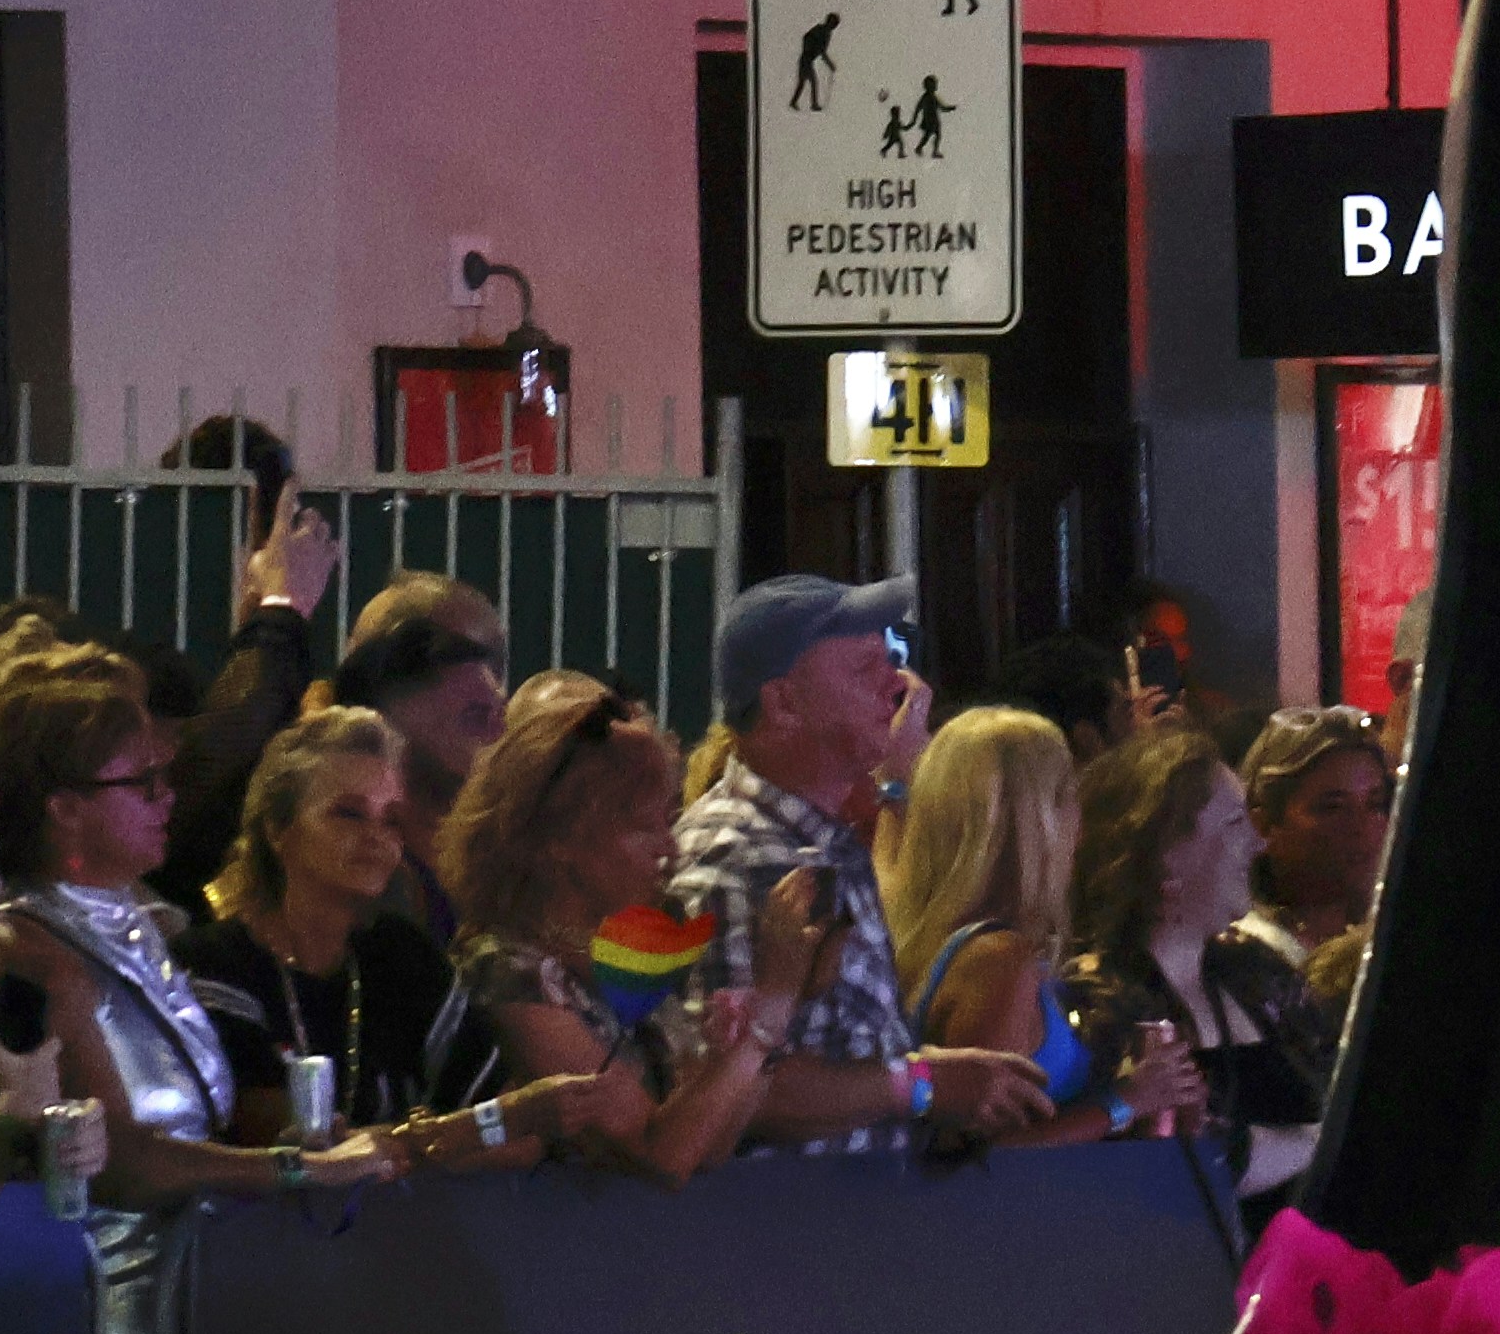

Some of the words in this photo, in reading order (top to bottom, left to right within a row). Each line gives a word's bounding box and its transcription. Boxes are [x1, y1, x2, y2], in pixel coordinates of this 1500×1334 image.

[847, 179, 917, 208] HIGH
[787, 222, 978, 255] PEDESTRIAN
[1342, 190, 1444, 278] BA
[814, 265, 950, 298] ACTIVITY
